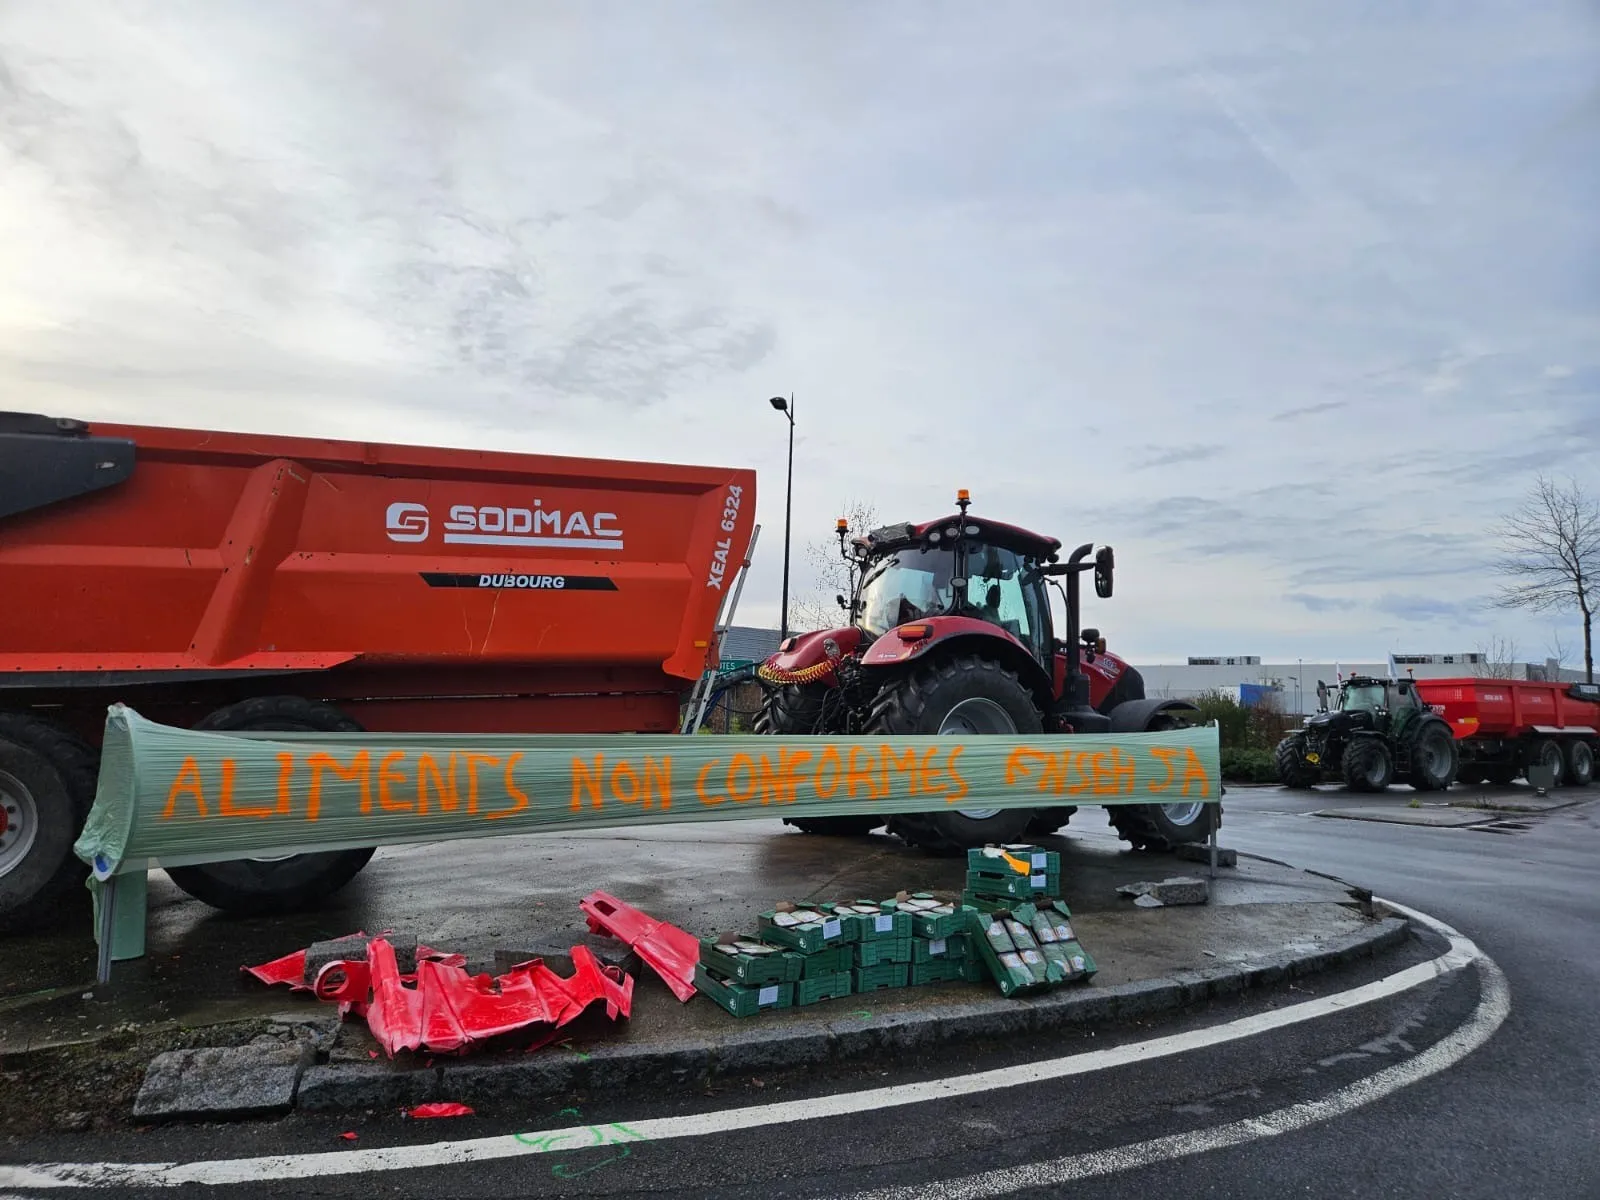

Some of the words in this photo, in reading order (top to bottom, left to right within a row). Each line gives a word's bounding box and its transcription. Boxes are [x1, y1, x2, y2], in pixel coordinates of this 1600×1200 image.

[707, 538, 732, 590] XEAL
[721, 485, 743, 532] 6324
[478, 574, 566, 589] DUBOURG
[162, 749, 530, 822] ALIMENTS
[568, 753, 673, 812] NON
[694, 744, 969, 805] CONFORMES
[1148, 747, 1210, 797] JA
